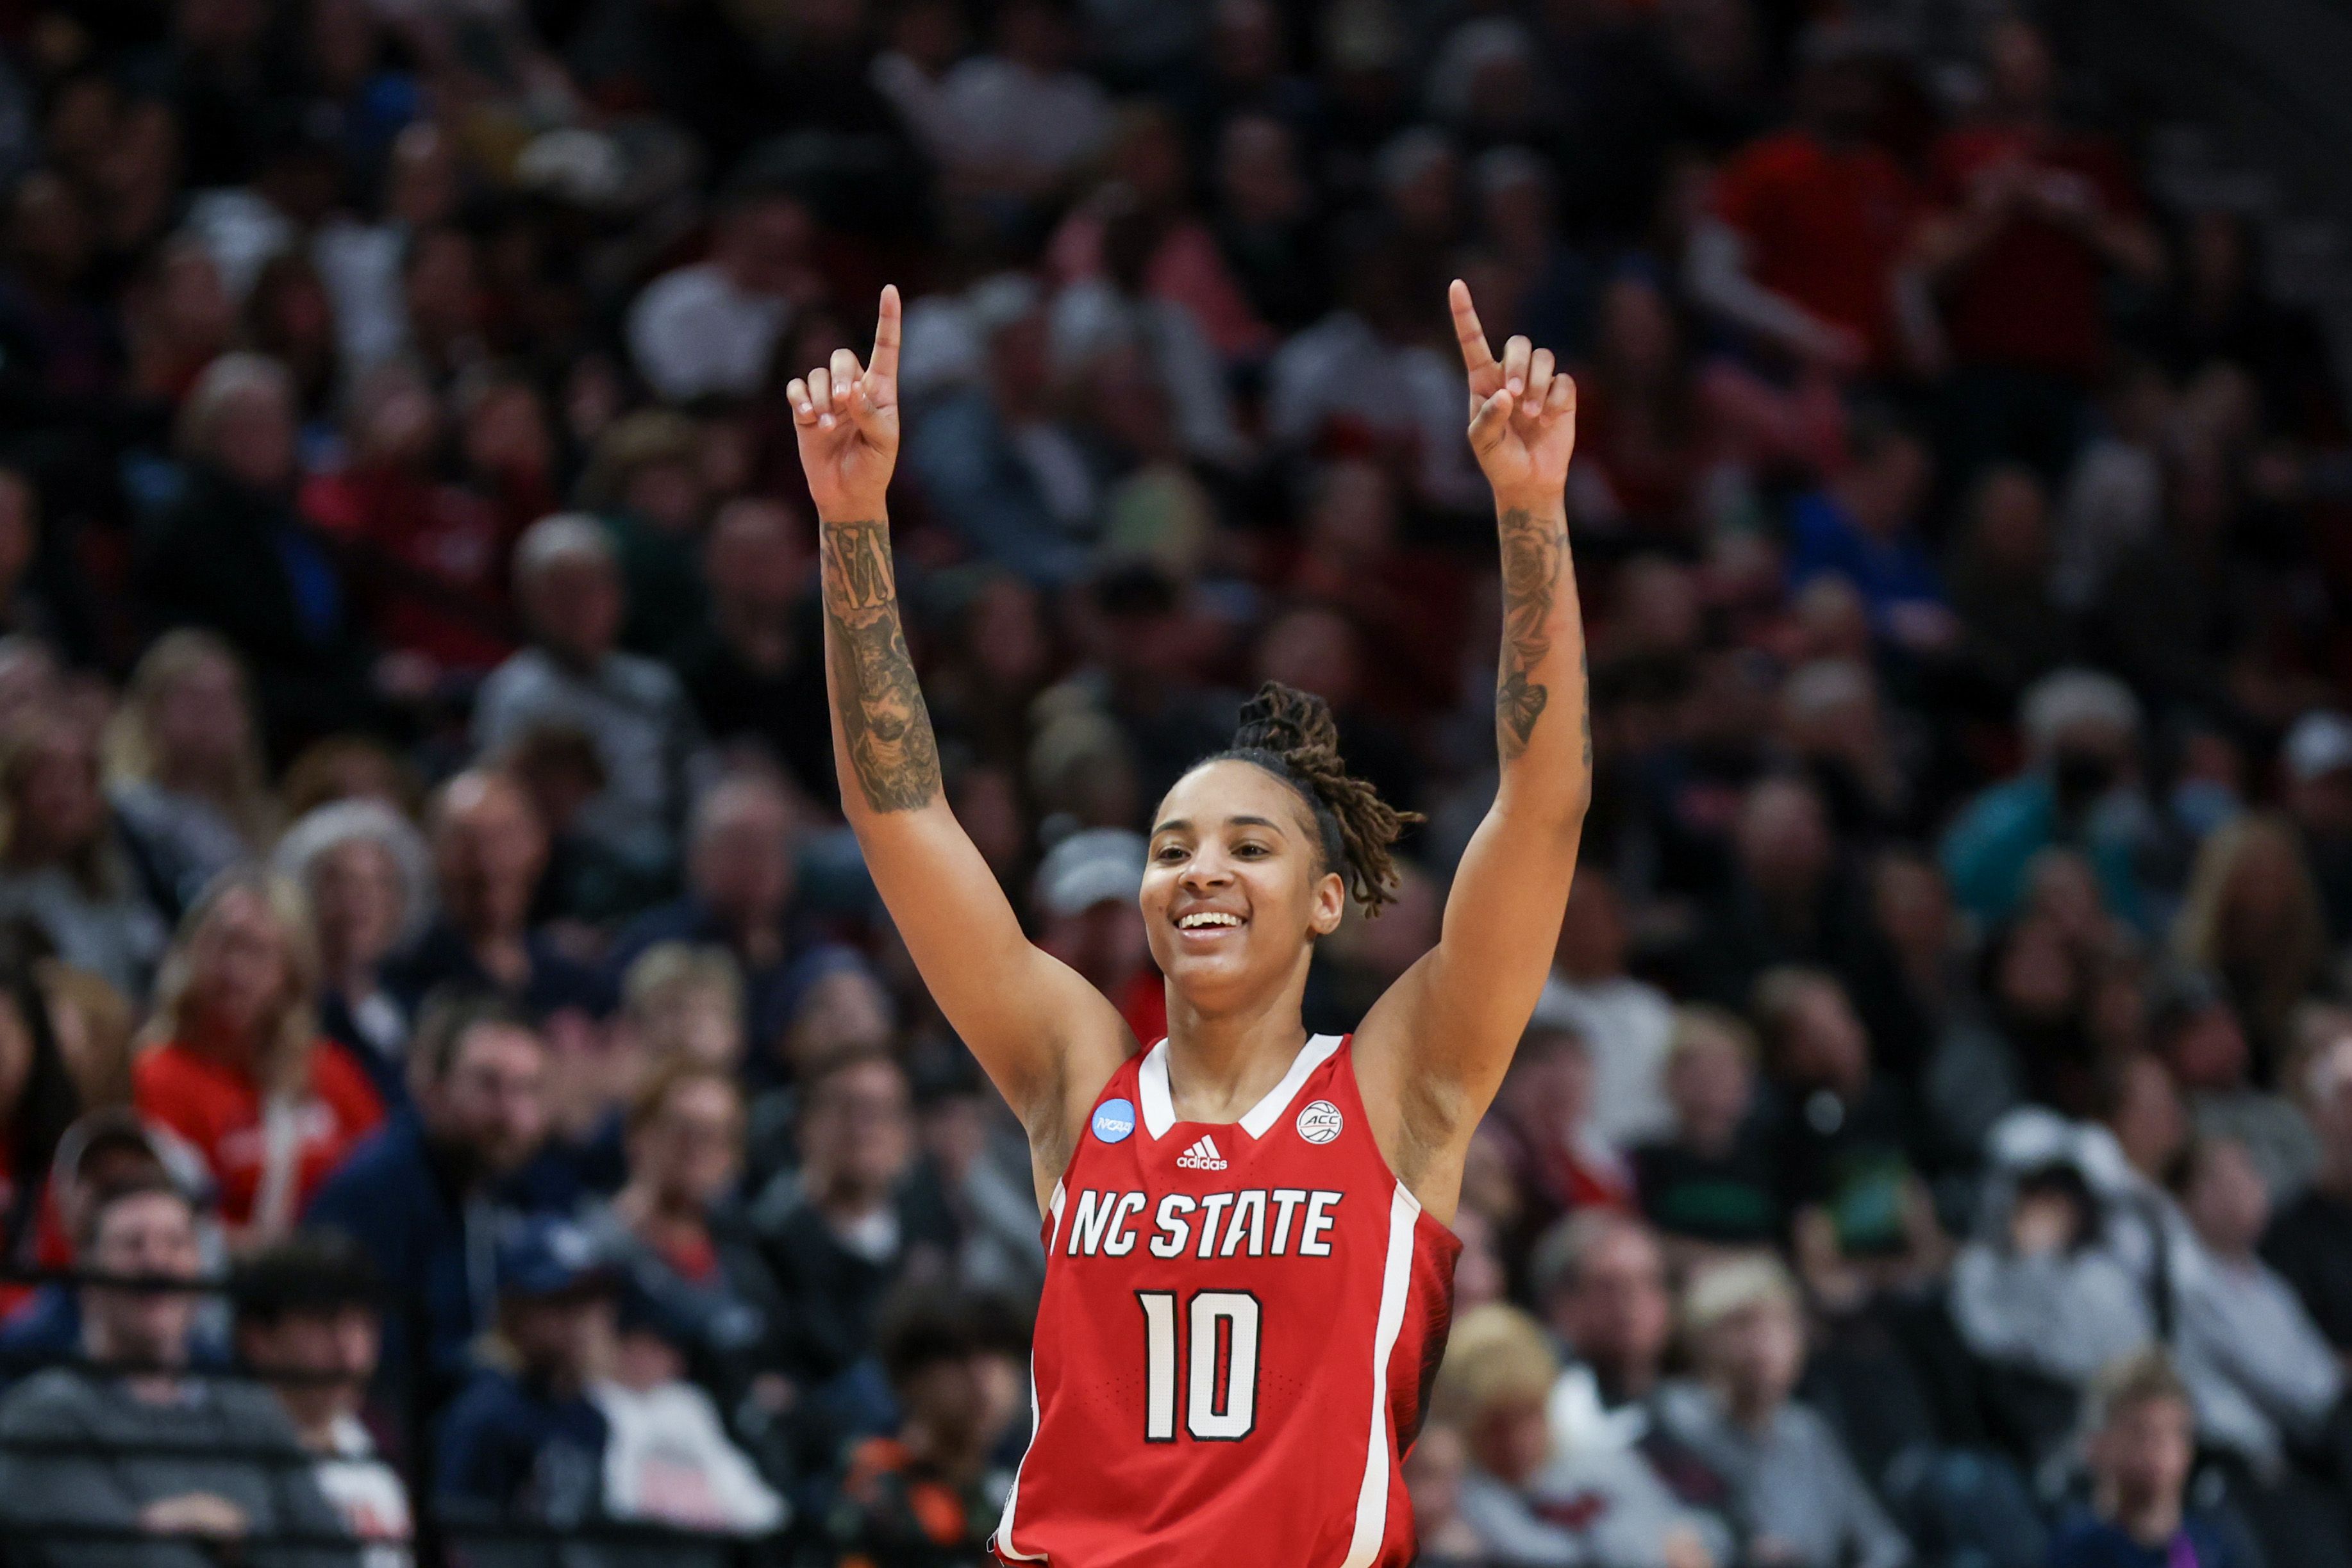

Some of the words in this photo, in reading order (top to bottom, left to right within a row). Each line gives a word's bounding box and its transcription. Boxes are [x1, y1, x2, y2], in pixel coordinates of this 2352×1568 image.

[1097, 1117, 1132, 1133] NCAA
[1304, 1115, 1339, 1125] ACC
[1176, 1155, 1228, 1171] adidas
[1067, 1189, 1147, 1256] NC
[1149, 1189, 1344, 1258] STATE
[1134, 1289, 1262, 1442] 10
